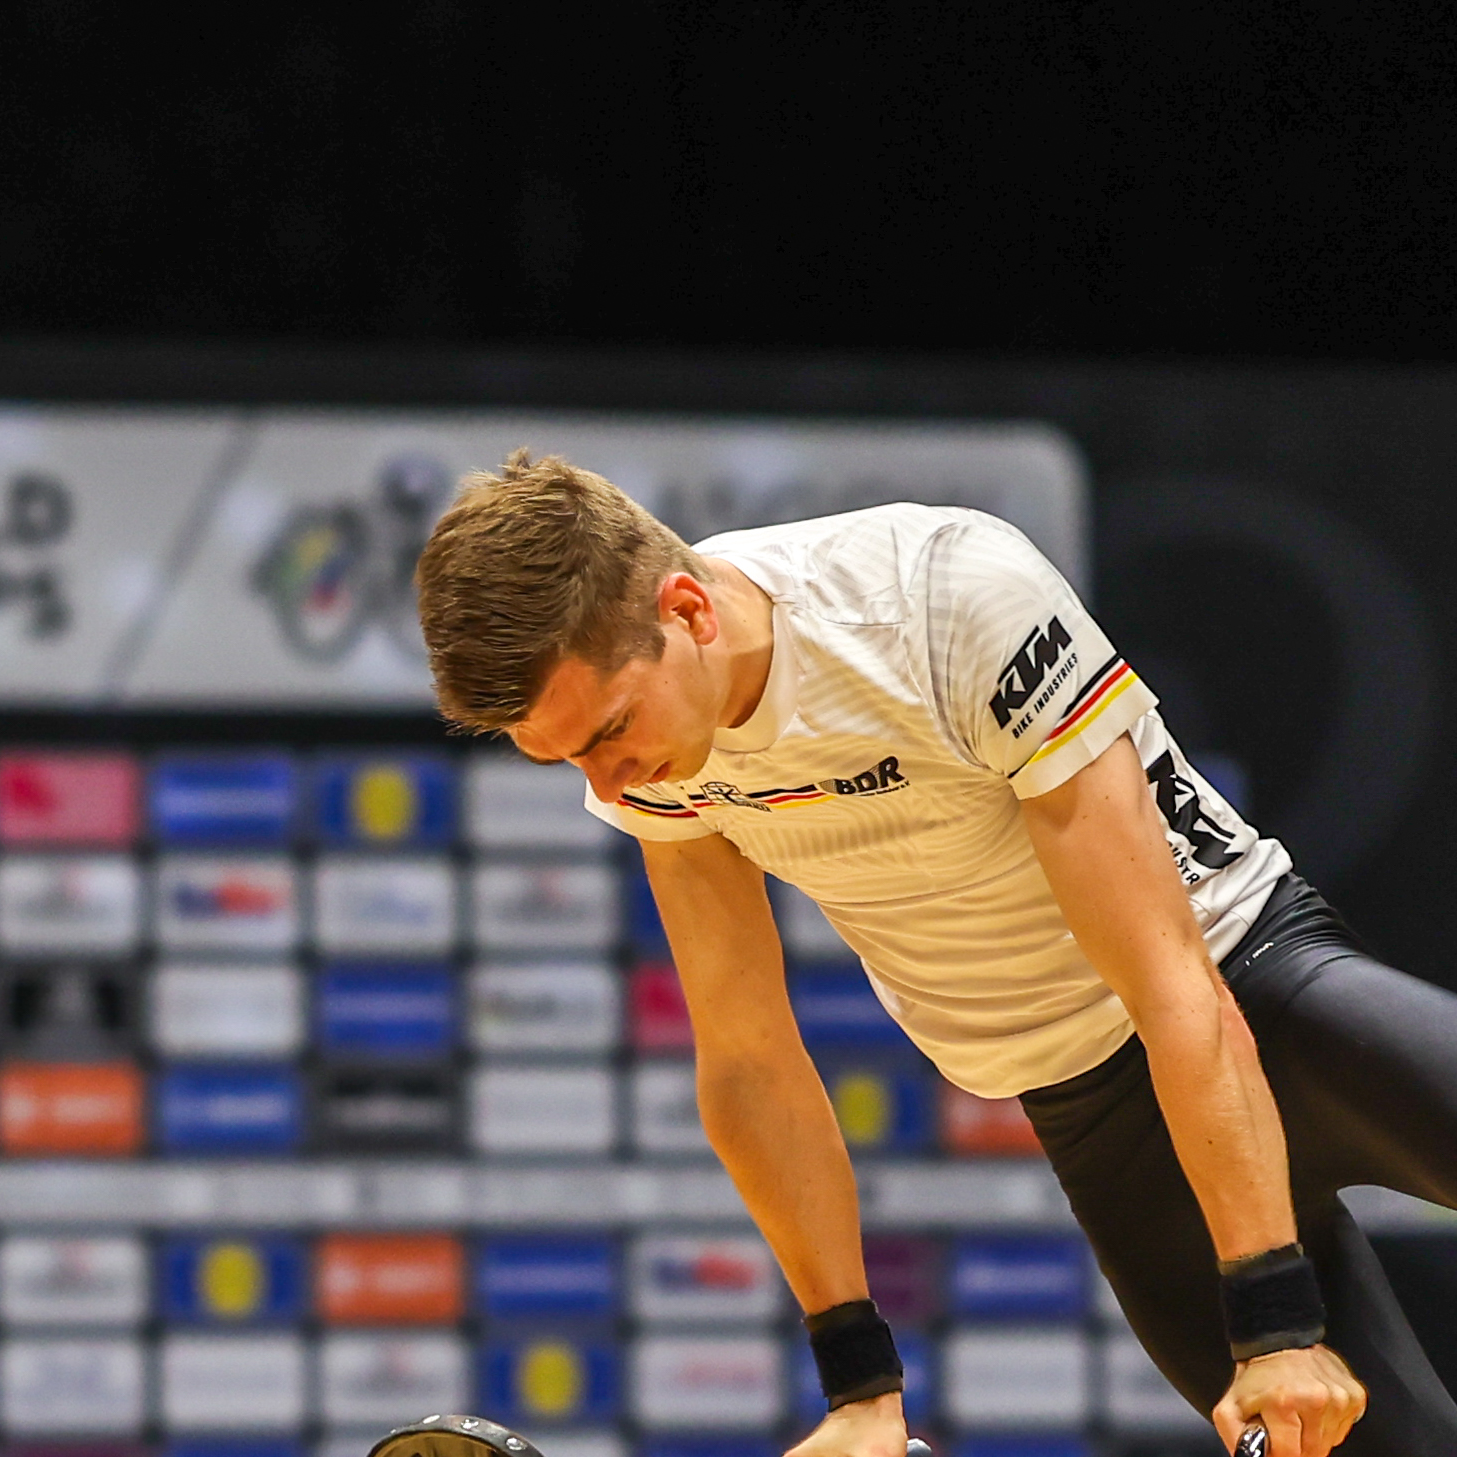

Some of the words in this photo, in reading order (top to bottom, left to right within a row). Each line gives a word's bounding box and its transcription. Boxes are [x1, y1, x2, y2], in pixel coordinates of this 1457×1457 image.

[989, 615, 1073, 730] KTM
[1011, 712, 1034, 739] BIKE
[1033, 652, 1078, 715] INDUSTRIES
[836, 755, 905, 796] BDR
